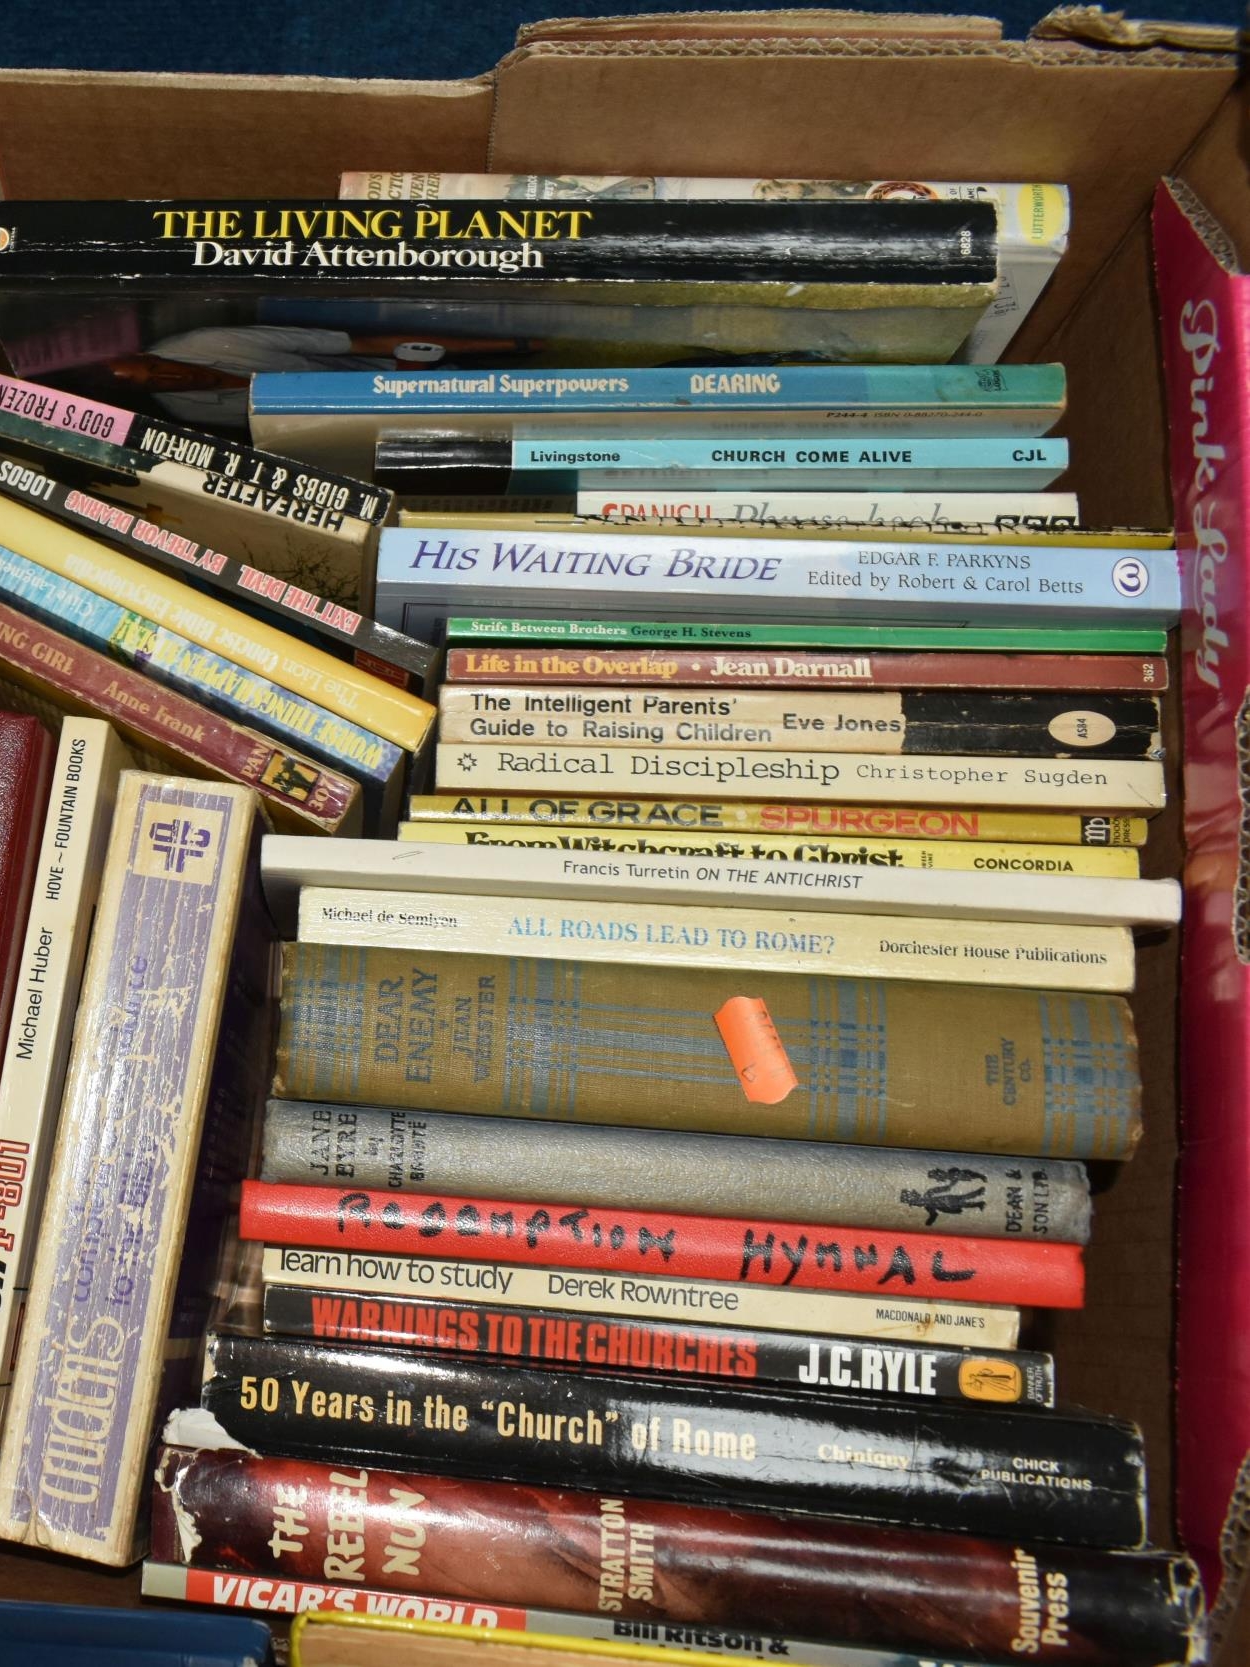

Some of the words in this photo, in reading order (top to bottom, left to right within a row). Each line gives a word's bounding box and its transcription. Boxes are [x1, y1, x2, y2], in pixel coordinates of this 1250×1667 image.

[1031, 183, 1044, 240] LUTTERWORTH
[192, 241, 293, 267] David
[300, 239, 544, 274] Attenborough
[1179, 298, 1227, 493] Pink
[62, 406, 115, 438] GOD'S
[140, 427, 216, 468] MORTON
[530, 450, 621, 464] Livingstone
[711, 449, 786, 463] CHURCH
[795, 450, 850, 463] COME
[858, 449, 912, 463] ALIVE
[1012, 448, 1047, 462] CJL
[271, 466, 288, 490] &
[293, 474, 350, 511] GIBBS
[64, 489, 135, 536] DEARING
[359, 492, 380, 519] M.
[132, 516, 200, 566] TREVOR
[198, 549, 228, 576] BY
[408, 539, 480, 571] HIS
[491, 541, 653, 577] WAITING
[662, 548, 783, 582] BRIDE
[237, 565, 289, 607] DEVIL
[807, 570, 862, 588] Edited
[869, 572, 891, 591] by
[898, 573, 955, 590] Robert
[963, 576, 979, 591] &
[984, 576, 1031, 593] Carol
[1038, 577, 1084, 595] Betts
[1193, 501, 1230, 691] Lady
[281, 586, 320, 619] THE
[316, 602, 362, 636] EXIT
[470, 620, 508, 635] Strife
[511, 621, 566, 635] Between
[569, 623, 628, 636] Brothers
[709, 656, 768, 678] Jean
[773, 656, 873, 679] Darnall
[102, 679, 151, 716] Anne
[153, 704, 206, 745] Frank
[470, 693, 511, 712] The
[524, 693, 633, 717] Intelligent
[642, 695, 738, 716] Parents'
[781, 712, 826, 732] Eve
[833, 713, 902, 734] Jones
[469, 717, 536, 738] Guide
[546, 720, 569, 738] to
[582, 719, 665, 744] Raising
[675, 721, 773, 744] Children
[66, 738, 87, 783] BOOKS
[240, 742, 271, 779] PAN
[496, 752, 615, 775] Radical
[630, 754, 841, 786] Discipleship
[855, 764, 1010, 785] Christopher
[1023, 768, 1109, 787] Sugden
[54, 785, 78, 850] FOUNTAIN
[759, 804, 980, 837] SPURGEON
[45, 865, 64, 901] HOVE
[563, 860, 621, 876] Francis
[625, 863, 691, 880] Turretin
[695, 866, 720, 881] ON
[726, 868, 758, 884] THE
[764, 870, 863, 889] ANTICHRIST
[972, 857, 1074, 873] CONCORDIA
[508, 916, 553, 938] ALL
[560, 919, 639, 943] ROADS
[645, 923, 709, 947] LEAD
[715, 927, 748, 949] TO
[753, 929, 836, 955] ROME?
[878, 939, 959, 958] Dorchester
[963, 943, 1011, 960] House
[1014, 946, 1108, 965] Publications
[29, 927, 54, 985] Huber
[16, 988, 43, 1060] Michael
[404, 966, 438, 1084] ENEMY
[309, 1108, 332, 1177] JANE
[1004, 1186, 1024, 1233] DEAN
[279, 1248, 342, 1276] learn
[345, 1253, 404, 1281] how
[406, 1258, 435, 1284] to
[439, 1263, 514, 1295] study
[875, 1307, 931, 1325] MACDONALD
[933, 1311, 953, 1326] AND
[953, 1312, 986, 1329] JANE'S
[311, 1296, 480, 1351] WARNINGS
[485, 1313, 522, 1356] TO
[527, 1317, 583, 1360] THE
[584, 1321, 758, 1379] CHURCHES
[980, 1468, 1093, 1492] PUBLICATIONS
[323, 1469, 370, 1583] REBEL
[382, 1488, 428, 1577] NUN
[598, 1497, 625, 1613] STRATTON
[629, 1523, 655, 1602] SMITH
[1010, 1547, 1042, 1655] Souvenir
[1041, 1572, 1070, 1648] Press
